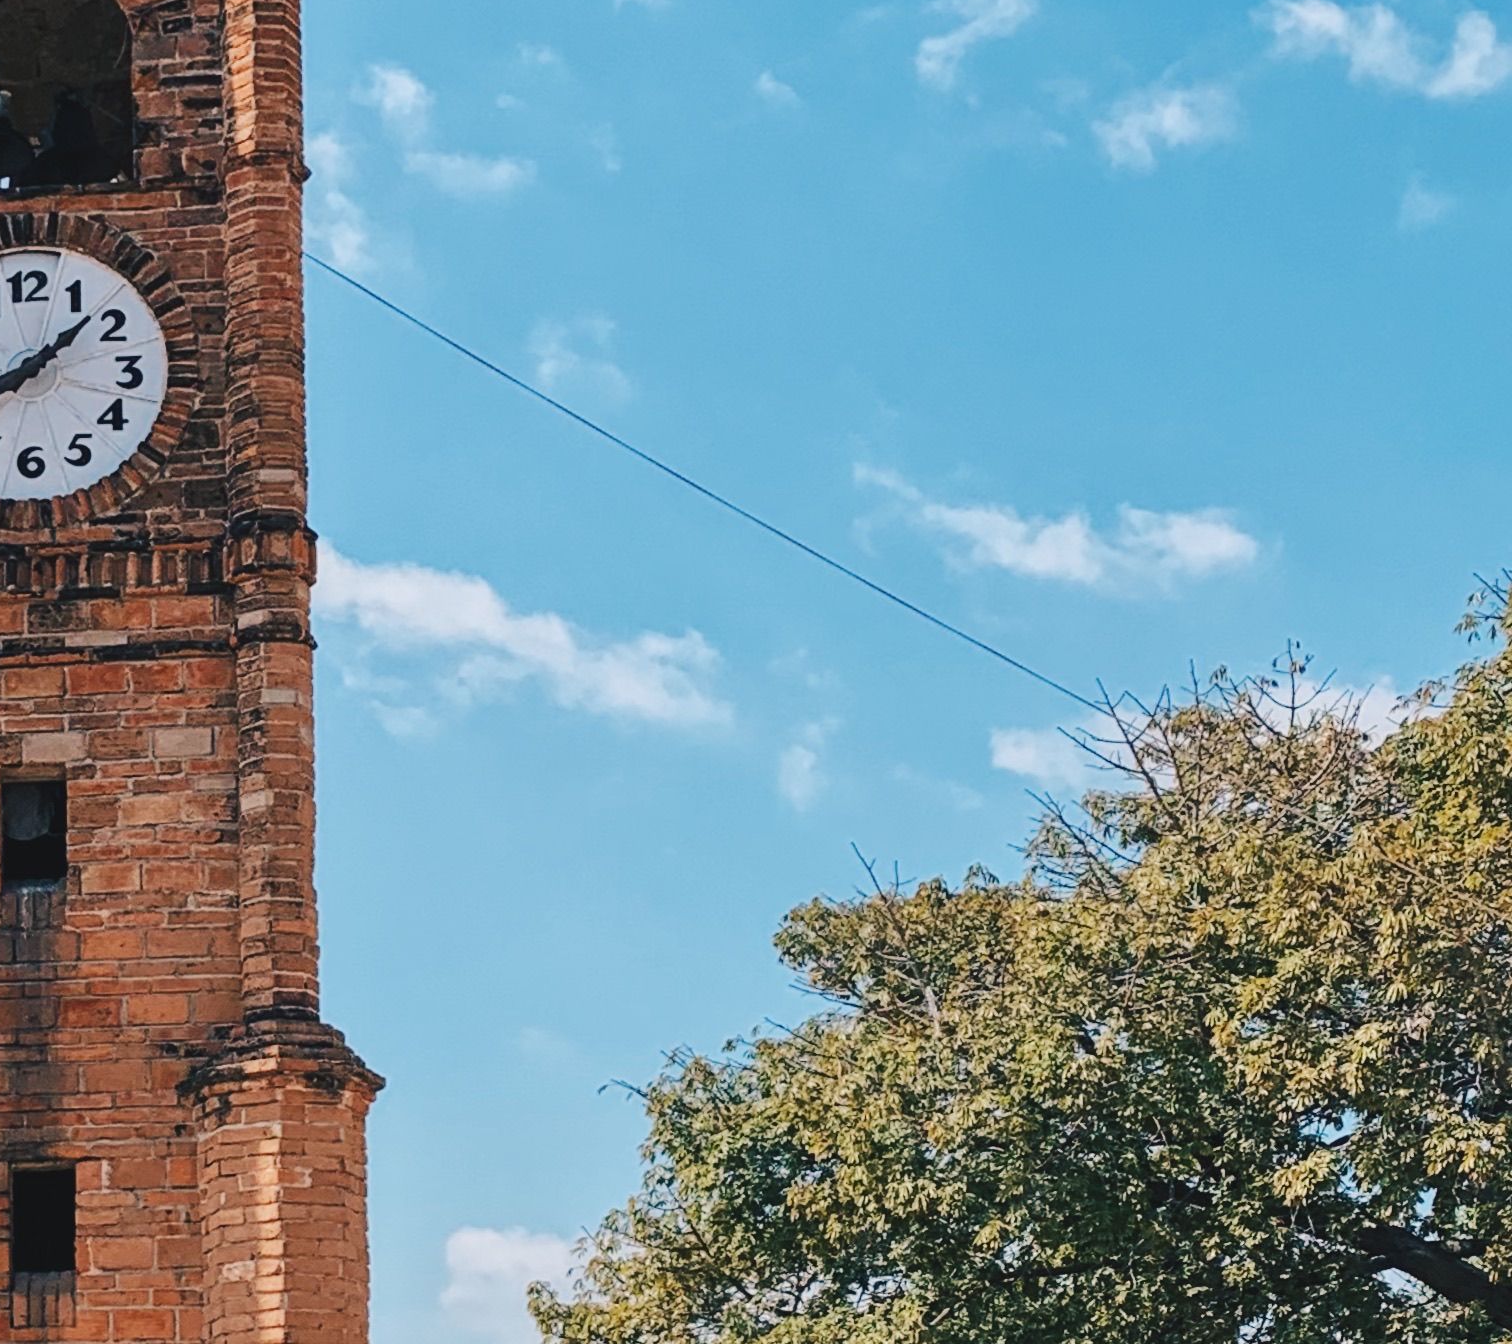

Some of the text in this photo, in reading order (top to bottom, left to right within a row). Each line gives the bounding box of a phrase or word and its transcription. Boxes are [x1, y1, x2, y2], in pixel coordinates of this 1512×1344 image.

[6, 270, 50, 303] 12
[65, 279, 82, 312] 1
[99, 308, 127, 342] 2
[114, 355, 144, 389] 3
[96, 398, 130, 431] 4
[16, 446, 46, 479] 6
[63, 433, 93, 467] 5
